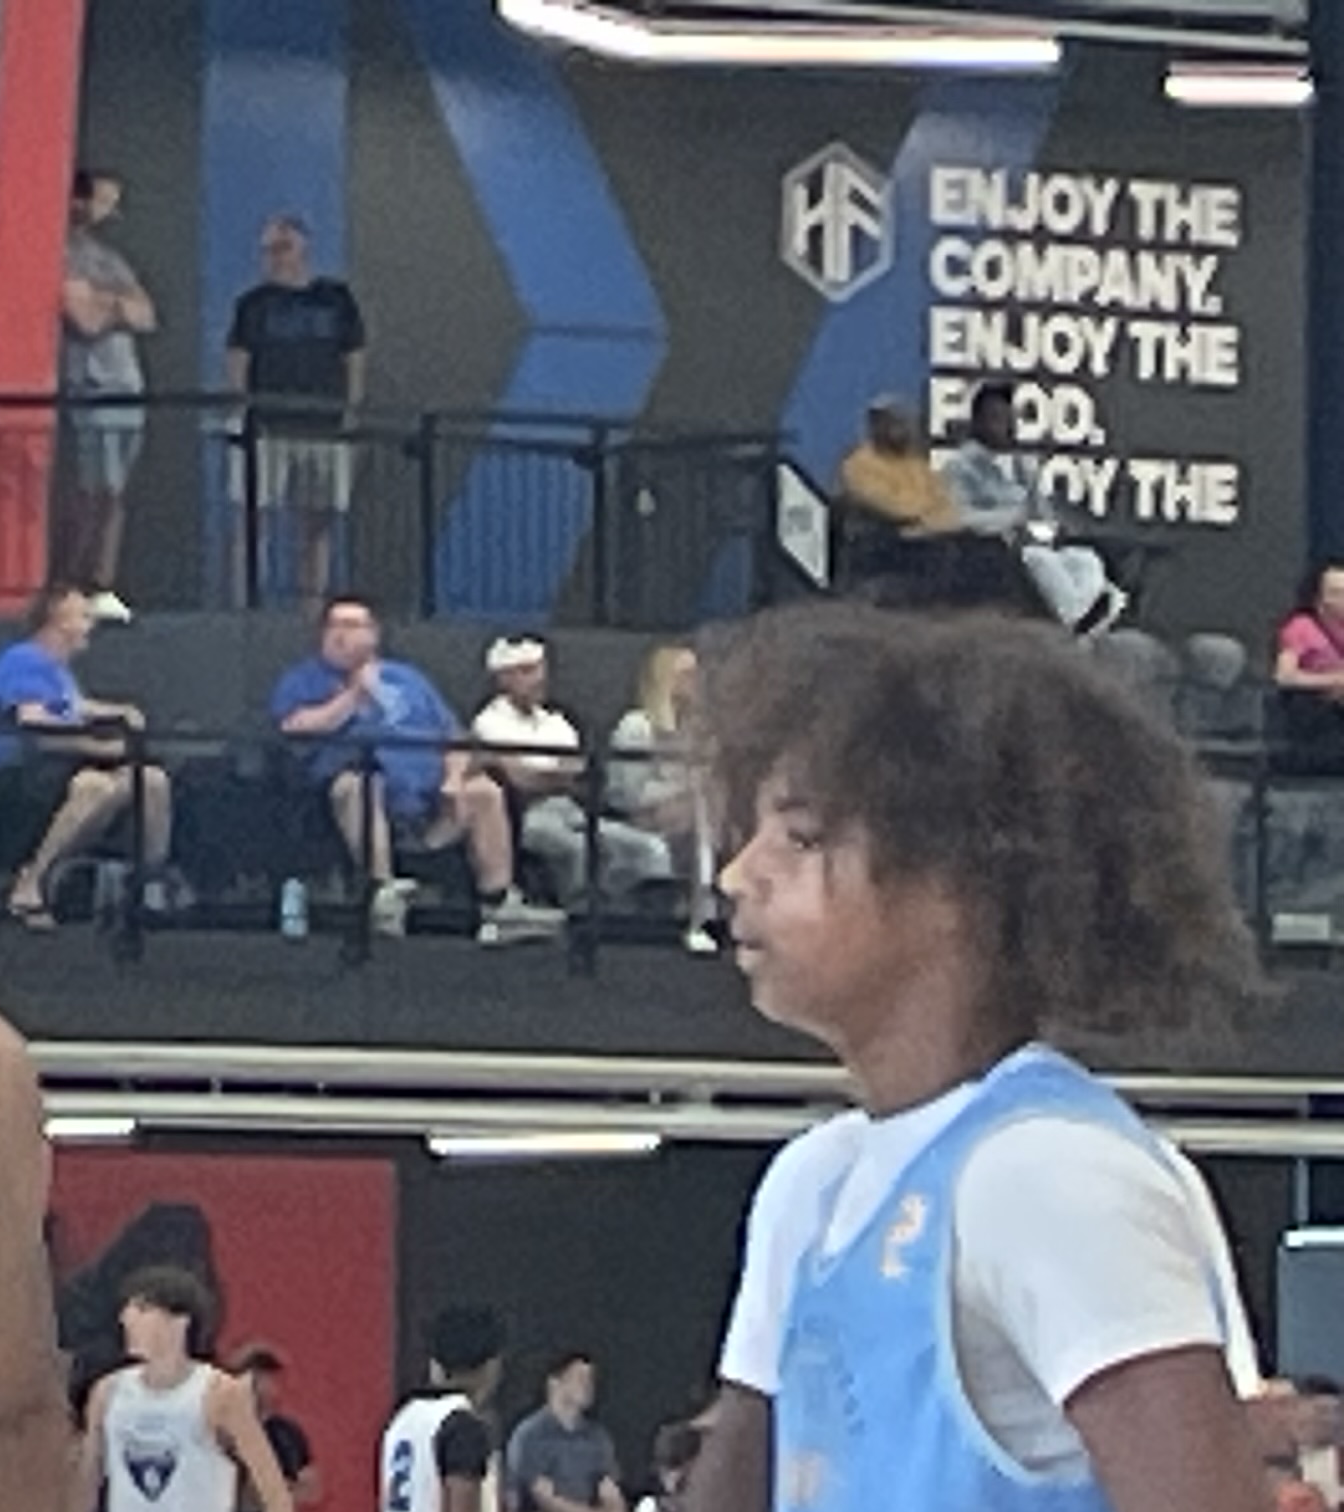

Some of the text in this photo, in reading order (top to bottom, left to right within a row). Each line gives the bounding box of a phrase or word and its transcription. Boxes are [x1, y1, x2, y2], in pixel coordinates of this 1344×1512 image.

[929, 165, 1240, 249] ENJOY THE
[929, 235, 1223, 316] COMPANY.
[929, 306, 1240, 386] ENJOY THE
[929, 376, 1106, 447] FOD.
[1127, 458, 1240, 525] THE
